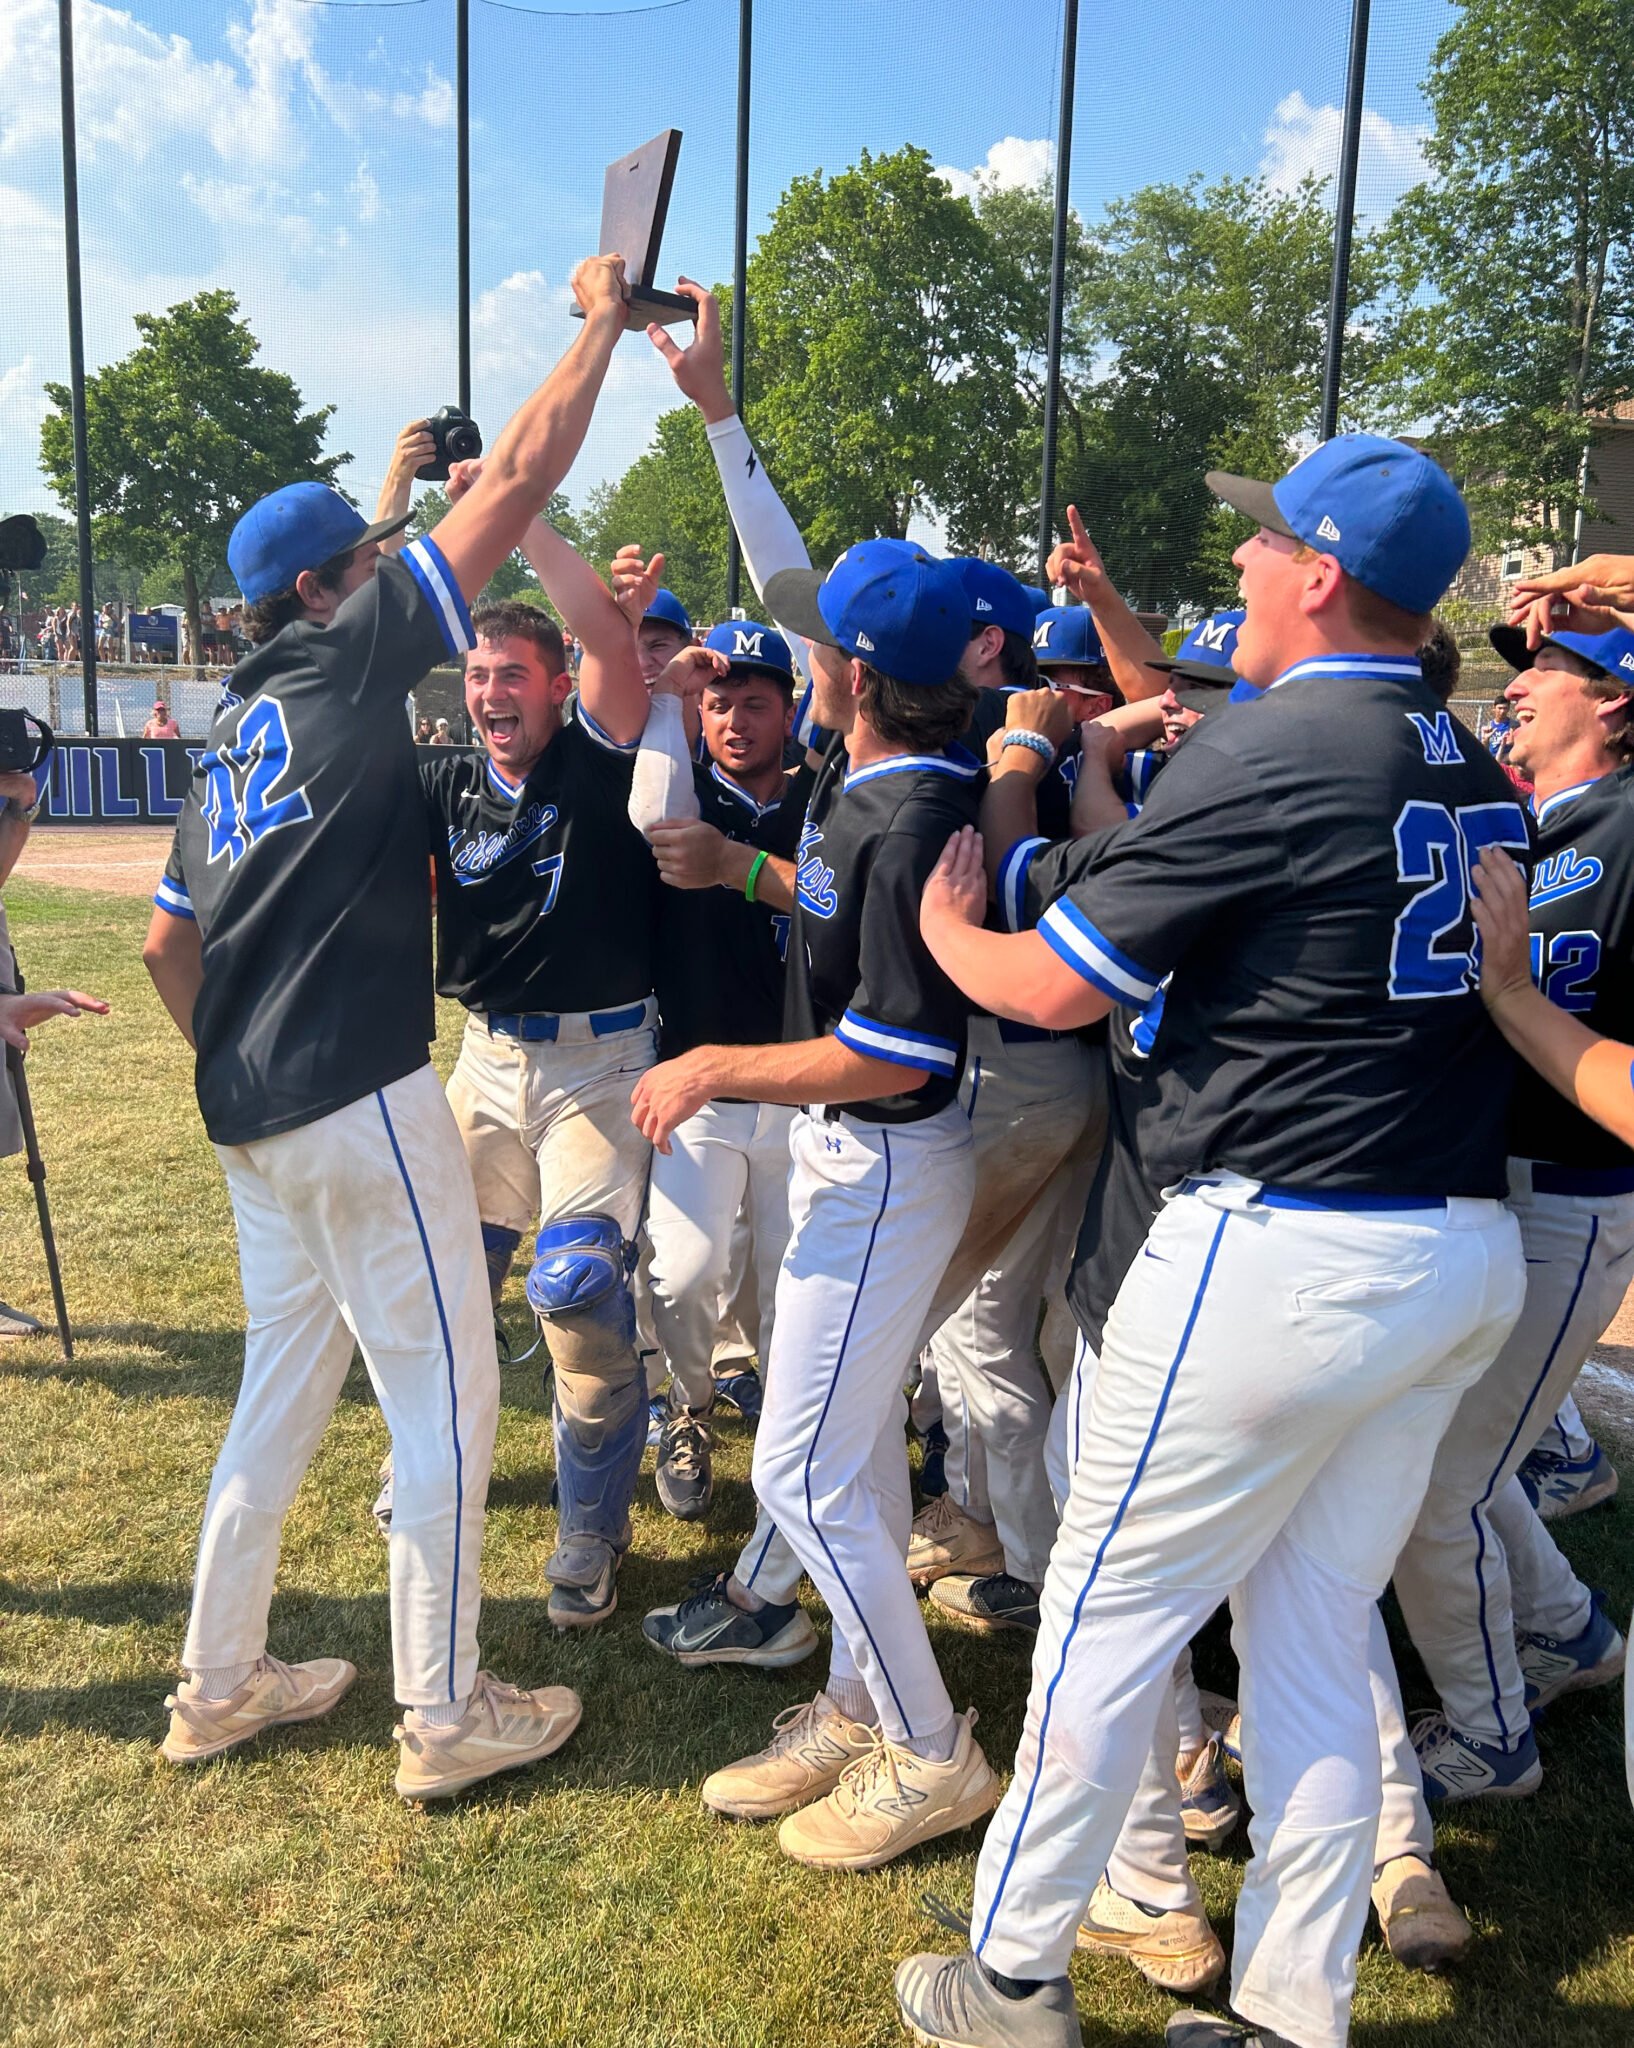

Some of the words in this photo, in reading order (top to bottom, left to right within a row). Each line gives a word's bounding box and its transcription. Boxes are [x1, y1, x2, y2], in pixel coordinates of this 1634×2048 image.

[732, 630, 764, 658] M
[1193, 619, 1237, 651] M
[1405, 711, 1466, 765] M
[31, 747, 206, 816] ILL
[531, 852, 564, 916] 7
